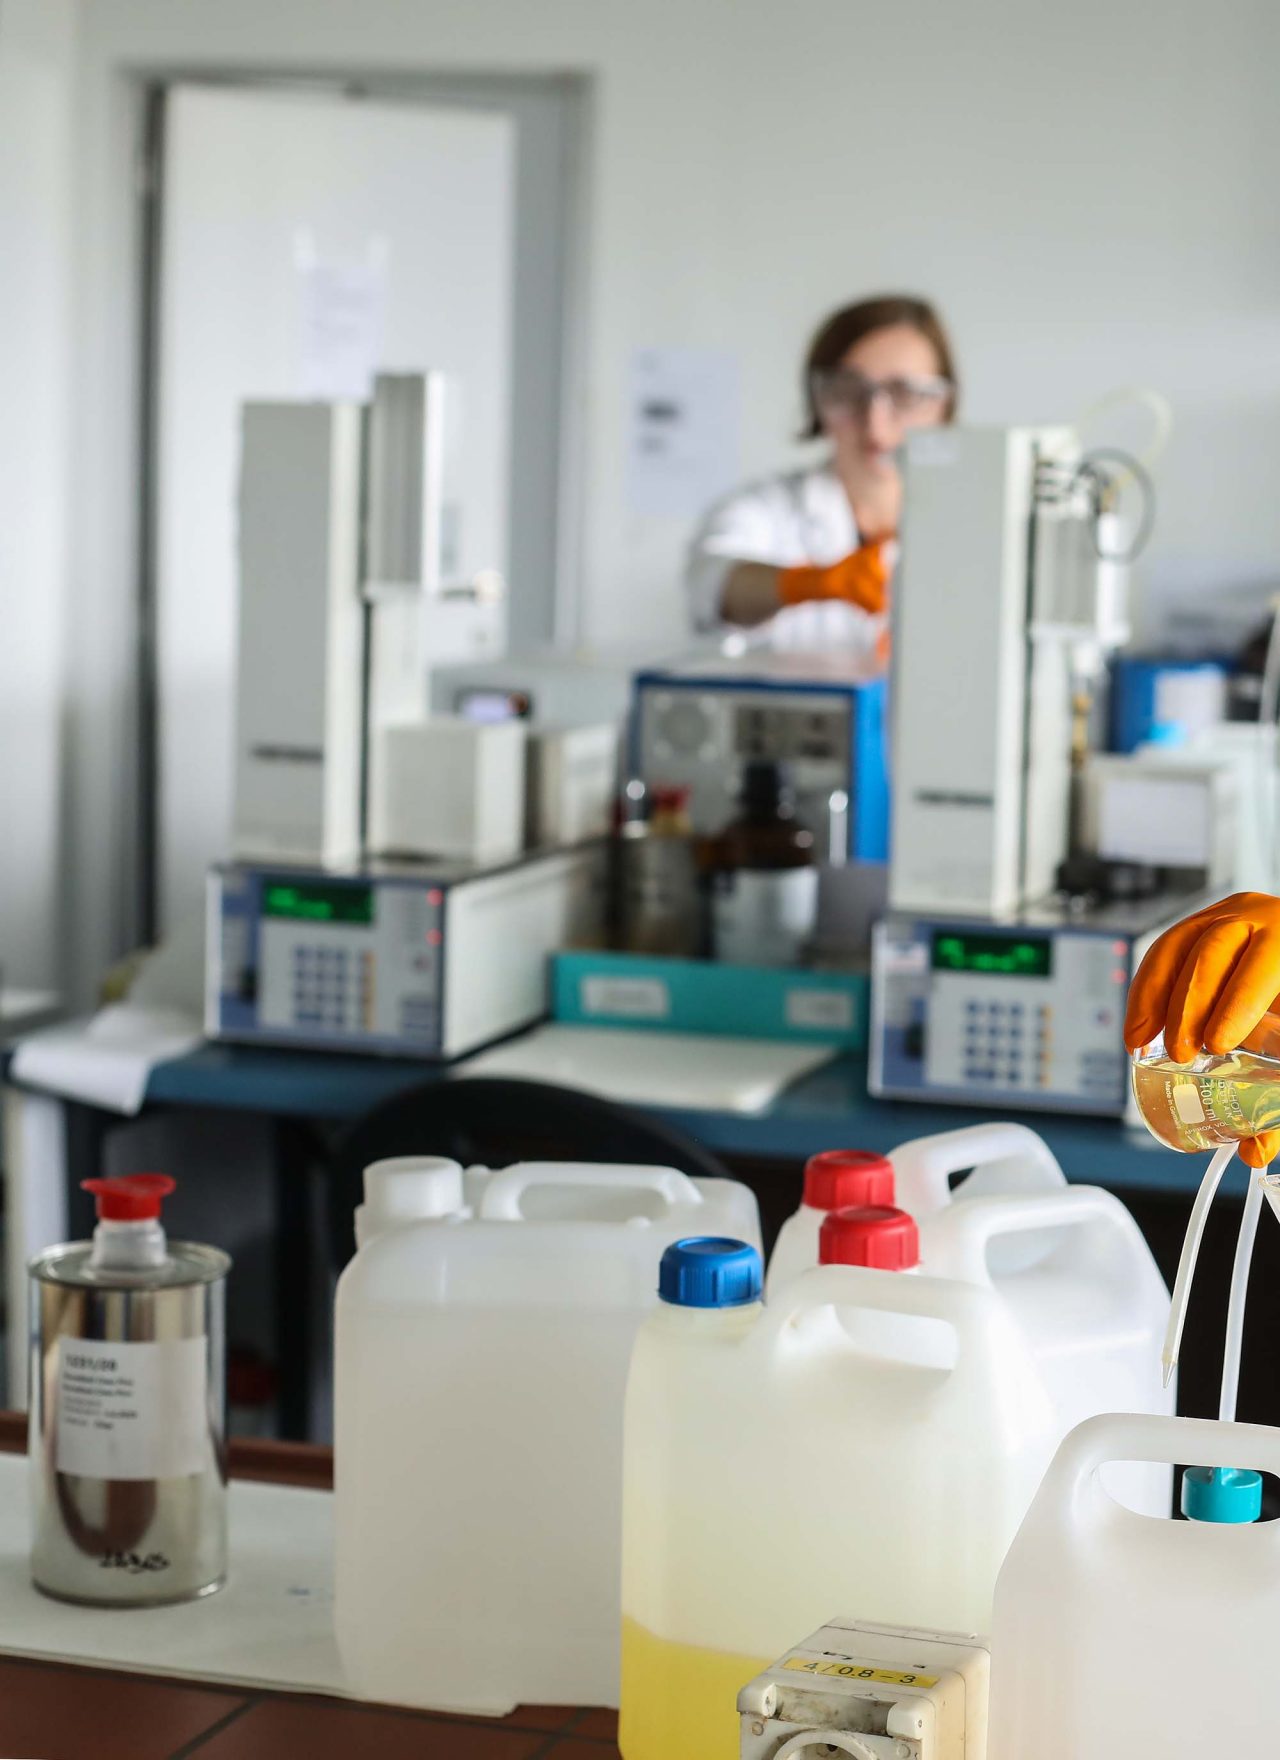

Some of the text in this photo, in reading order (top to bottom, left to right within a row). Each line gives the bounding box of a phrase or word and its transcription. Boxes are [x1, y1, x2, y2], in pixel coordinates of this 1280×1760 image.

[1164, 1081, 1173, 1099] Made
[1200, 1082, 1221, 1121] 100 ml
[1217, 1080, 1232, 1119] DURAN
